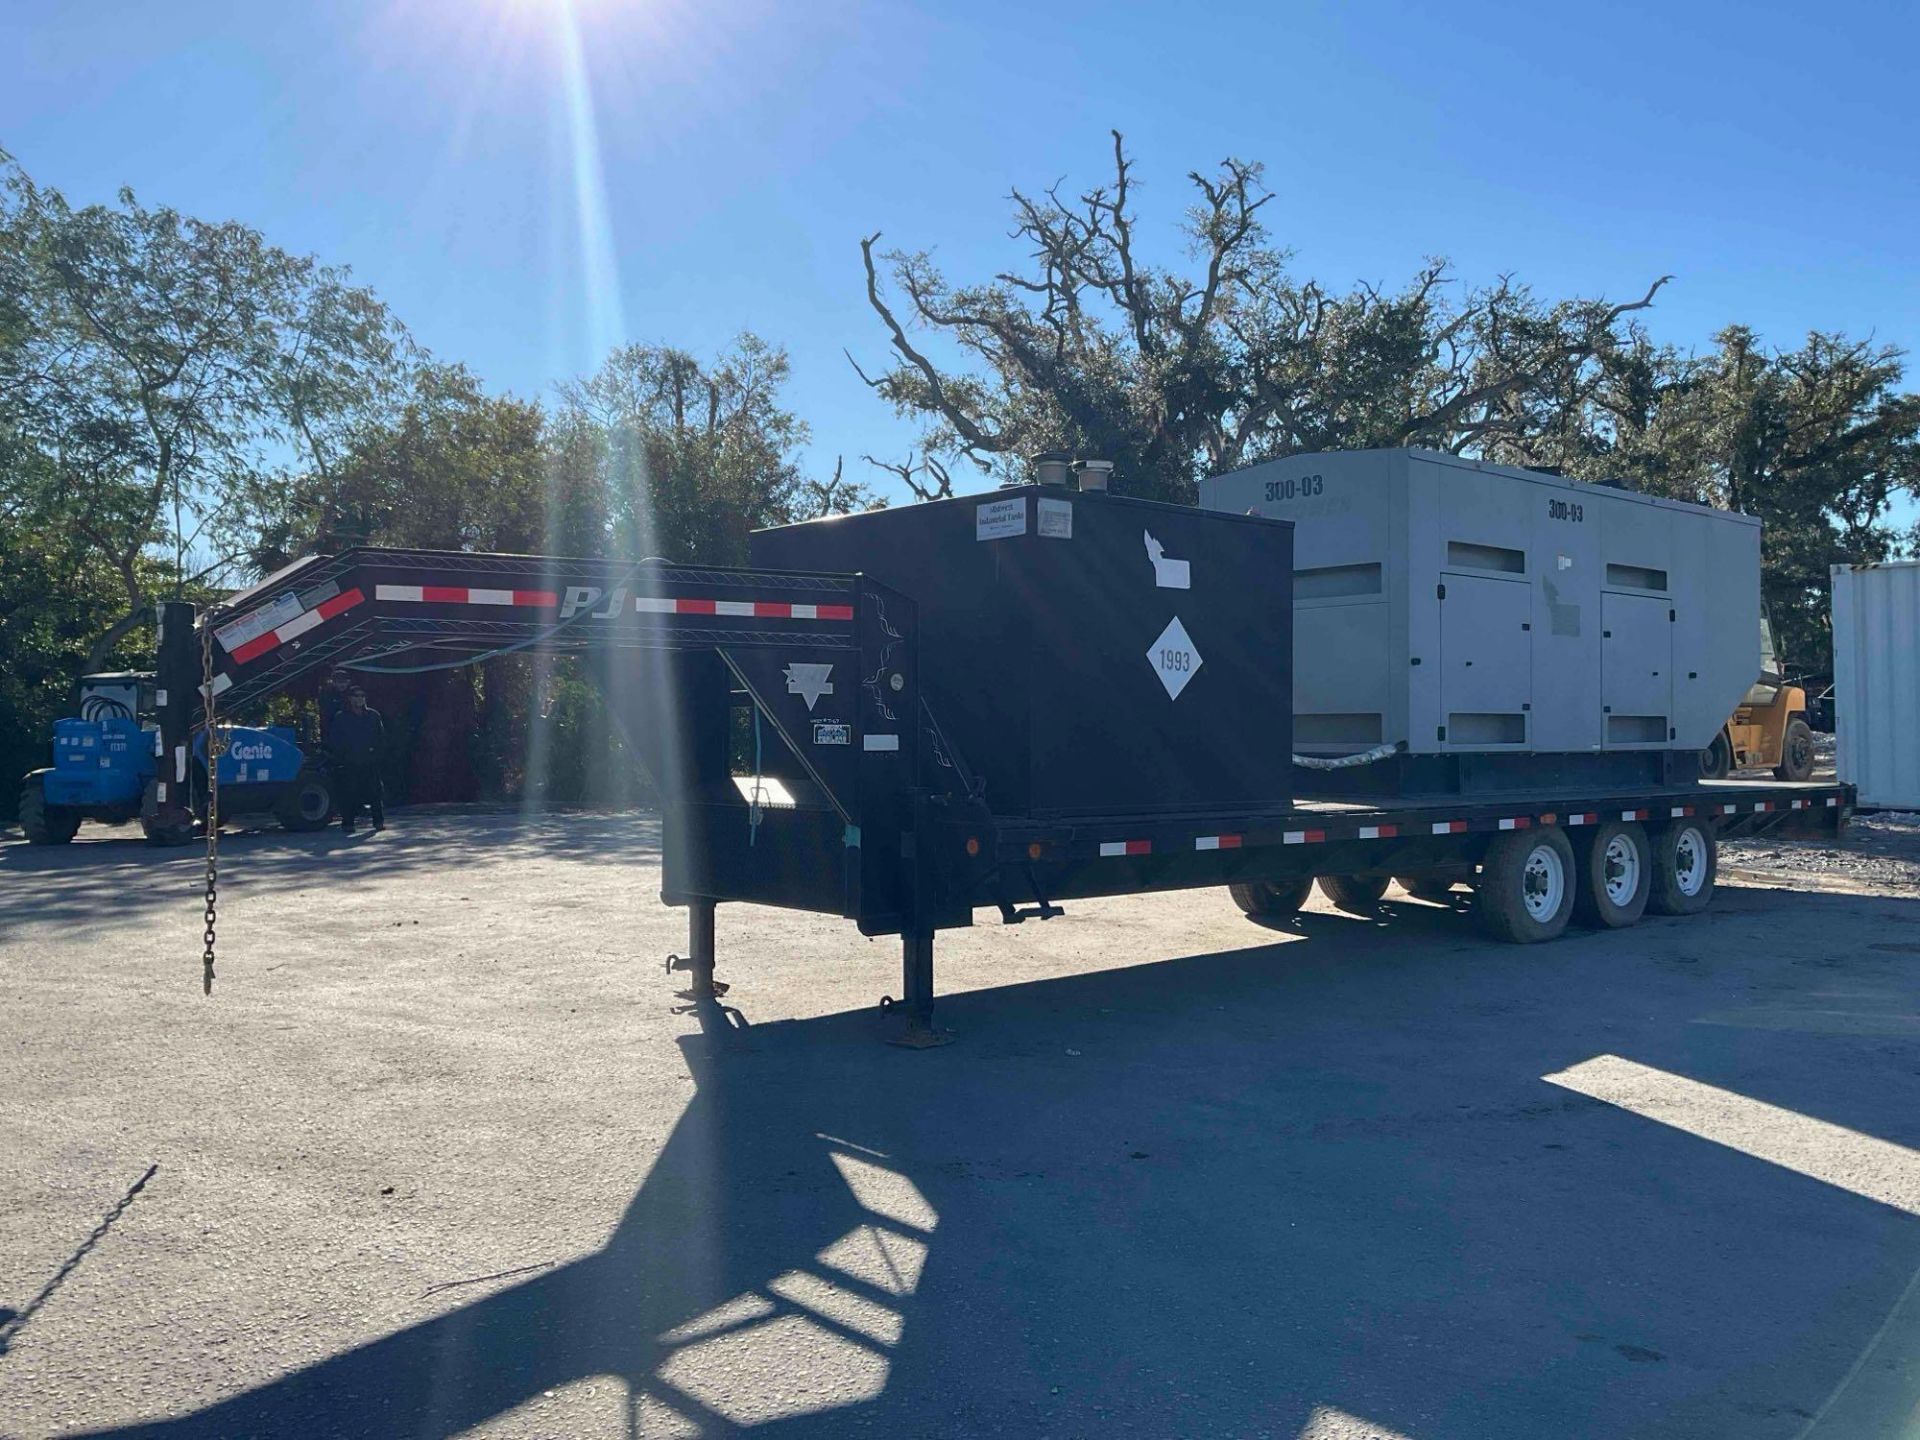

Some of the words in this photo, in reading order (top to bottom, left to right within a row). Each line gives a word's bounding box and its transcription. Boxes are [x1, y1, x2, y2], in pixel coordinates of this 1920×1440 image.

[1265, 474, 1323, 501] 300-03
[1549, 499, 1583, 522] 300-03
[560, 586, 628, 618] PJ
[1160, 649, 1190, 672] 1993
[231, 741, 272, 760] Genie
